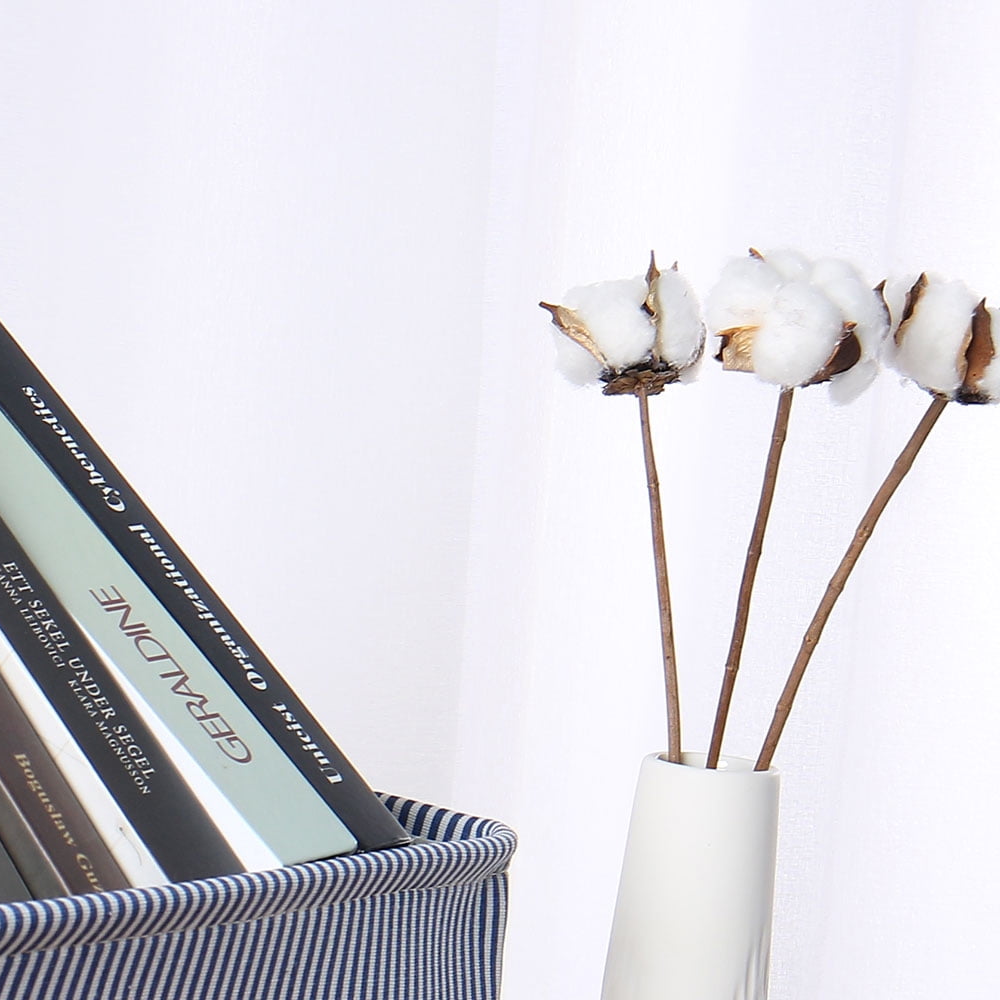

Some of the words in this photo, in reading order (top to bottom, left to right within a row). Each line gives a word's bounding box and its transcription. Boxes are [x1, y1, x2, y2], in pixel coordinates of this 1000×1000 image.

[22, 385, 127, 513] Cybernetics
[2, 561, 34, 593] ETT
[28, 599, 70, 653] SEKEL
[68, 657, 116, 719] UNDER
[112, 724, 155, 779] SEGEL
[89, 585, 252, 764] GERALDINE
[128, 523, 267, 691] Organizational
[20, 608, 65, 668] LEIBOVICI
[68, 679, 98, 718] KLARA
[96, 721, 151, 795] MAGNUSSON
[272, 702, 343, 784] Unicist
